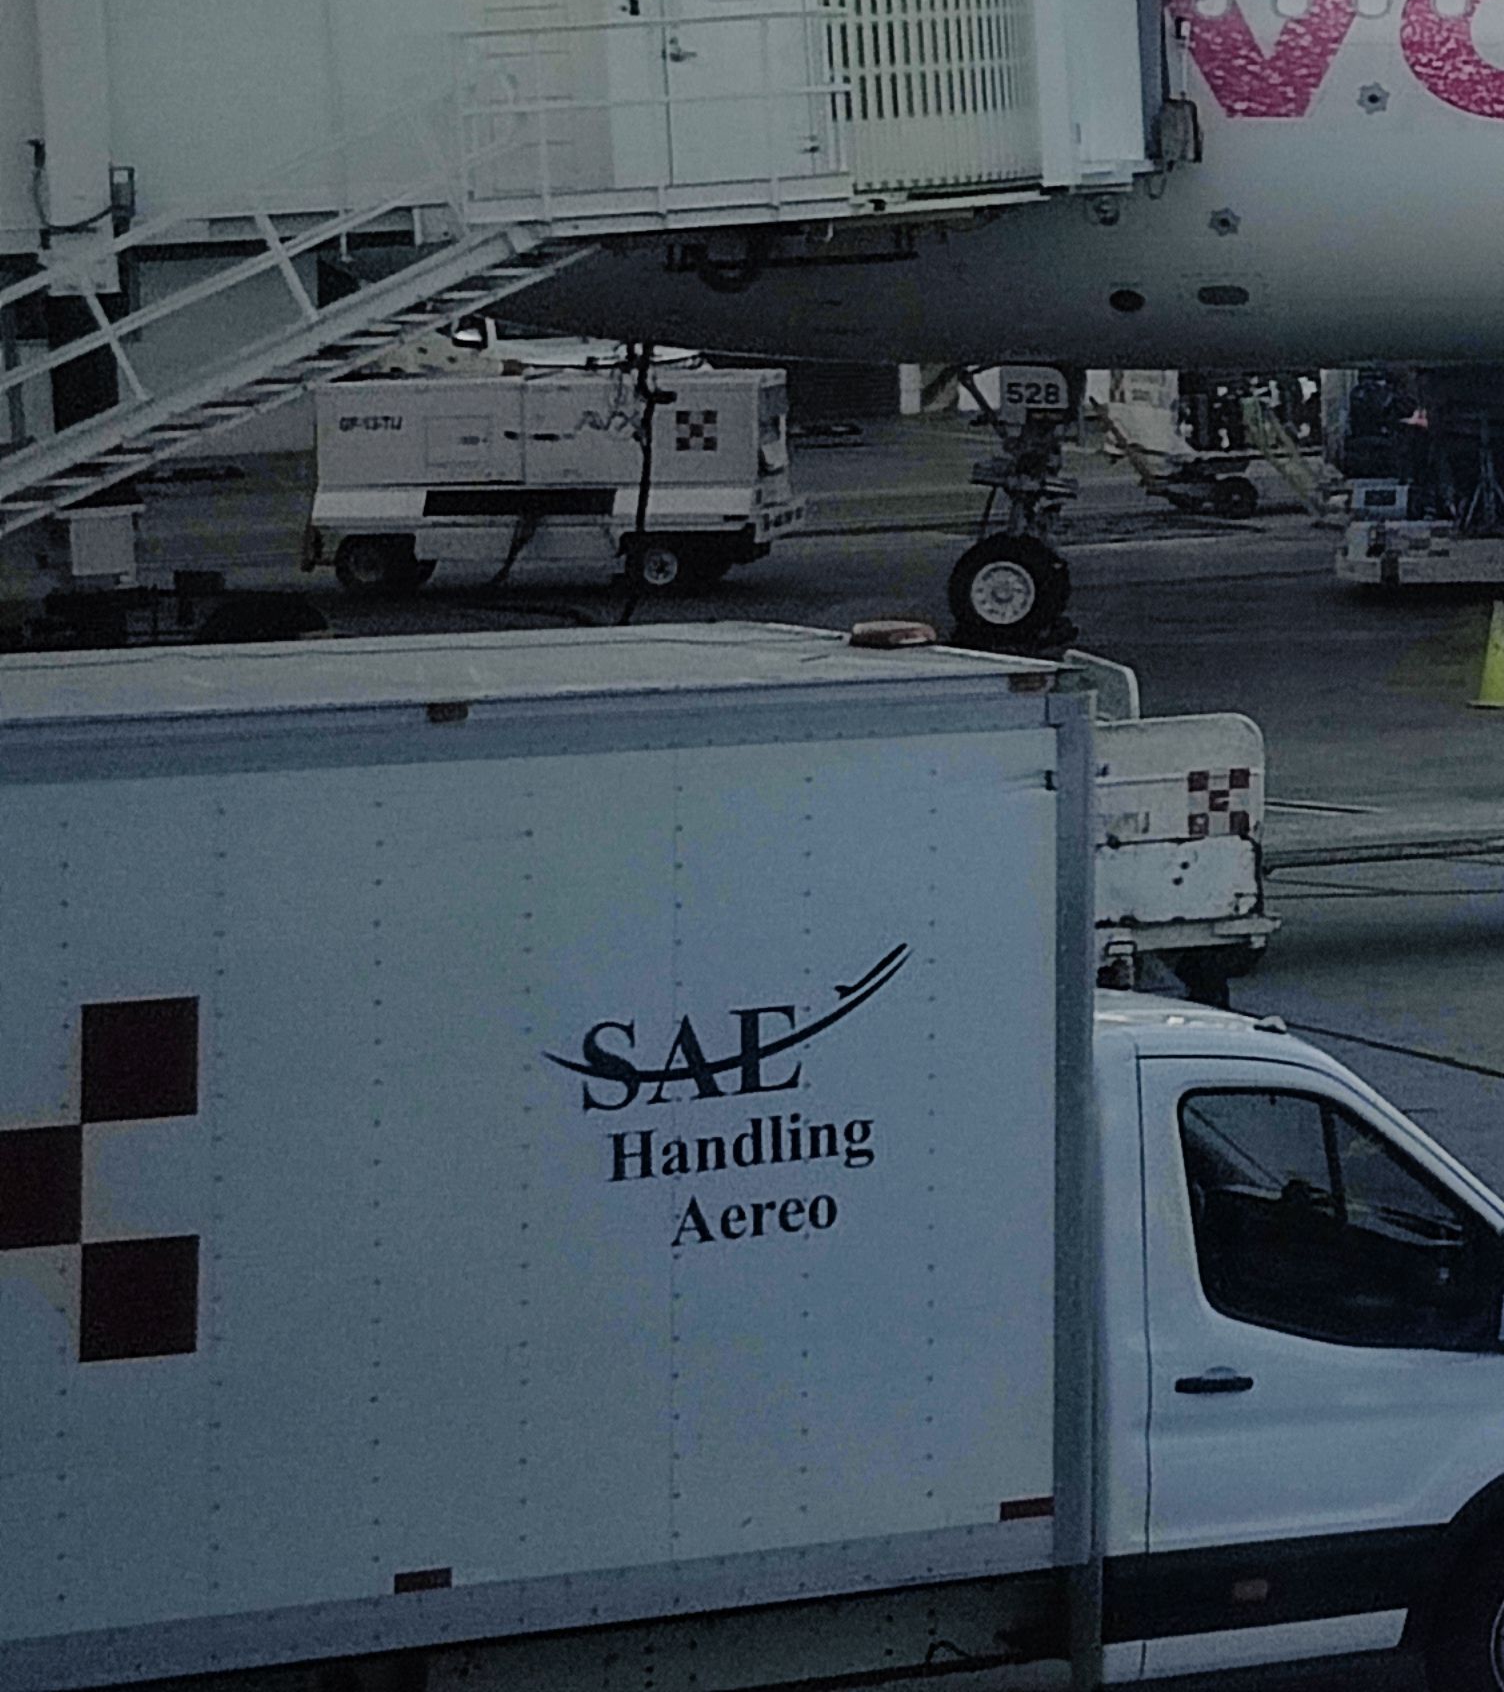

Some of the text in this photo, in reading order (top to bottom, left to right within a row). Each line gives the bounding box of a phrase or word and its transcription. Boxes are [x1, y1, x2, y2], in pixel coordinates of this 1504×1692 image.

[1005, 381, 1061, 405] 528
[581, 1004, 803, 1113] SAE
[607, 1114, 876, 1183] Handling
[670, 1194, 839, 1248] Aereo
